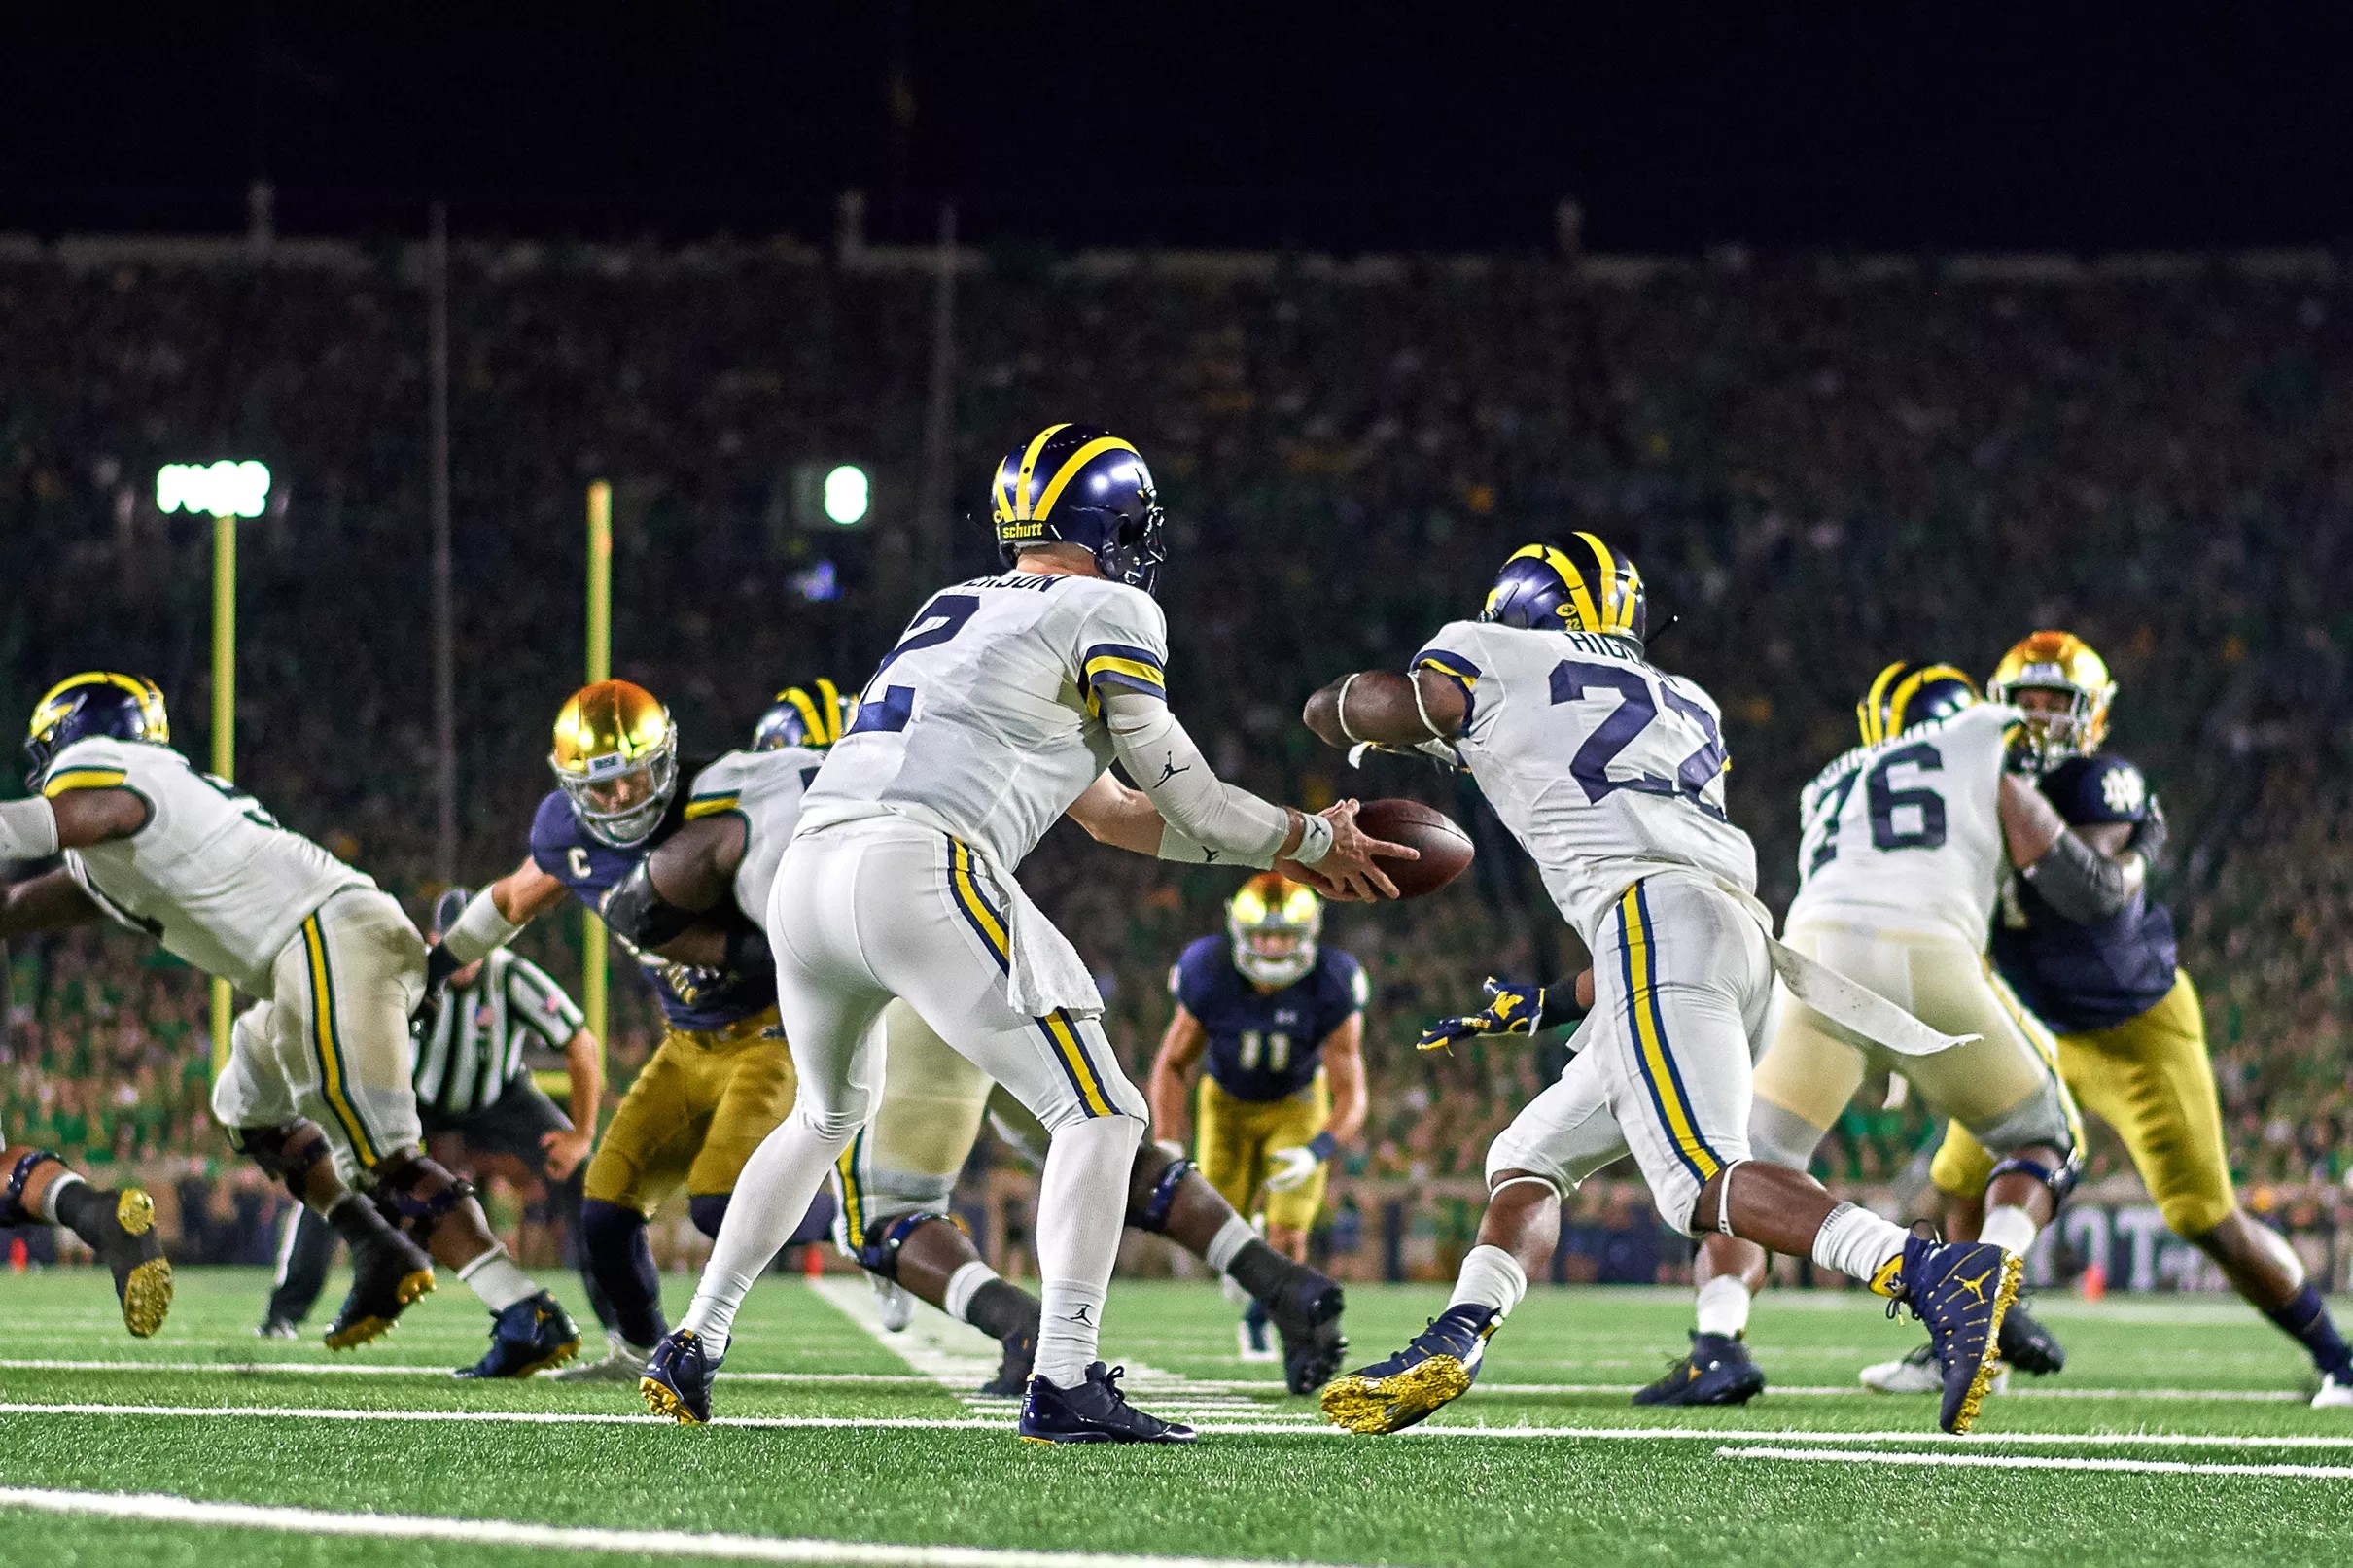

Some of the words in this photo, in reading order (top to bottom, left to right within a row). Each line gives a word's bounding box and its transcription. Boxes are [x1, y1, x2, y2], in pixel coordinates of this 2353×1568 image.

[1002, 523, 1043, 539] schutt
[847, 594, 981, 736] 2
[1548, 658, 1727, 823] 22
[1808, 740, 1948, 878] 76
[567, 847, 593, 881] C
[1238, 1028, 1291, 1073] 11
